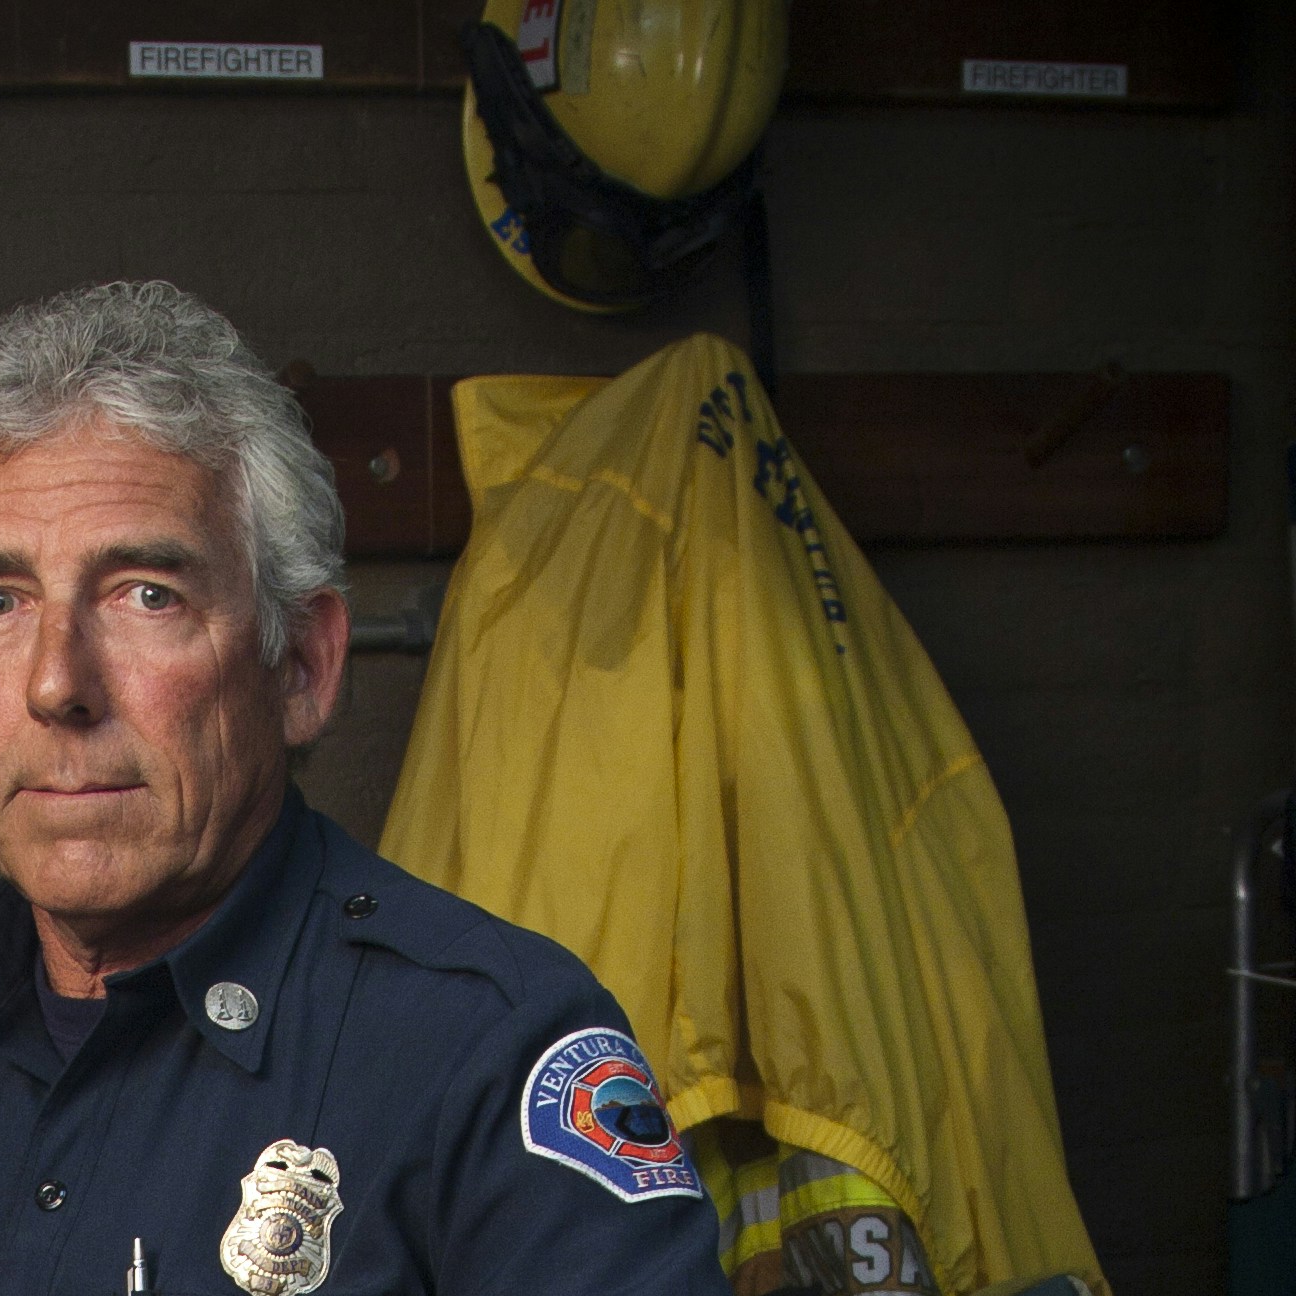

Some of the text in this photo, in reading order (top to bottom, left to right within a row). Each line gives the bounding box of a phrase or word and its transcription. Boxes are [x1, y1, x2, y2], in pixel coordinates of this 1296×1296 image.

[140, 46, 313, 73] FIREFIGHTER
[972, 63, 1120, 95] FIREFIGHTER
[536, 1036, 626, 1108] VENTURA
[632, 1168, 694, 1189] FIRE
